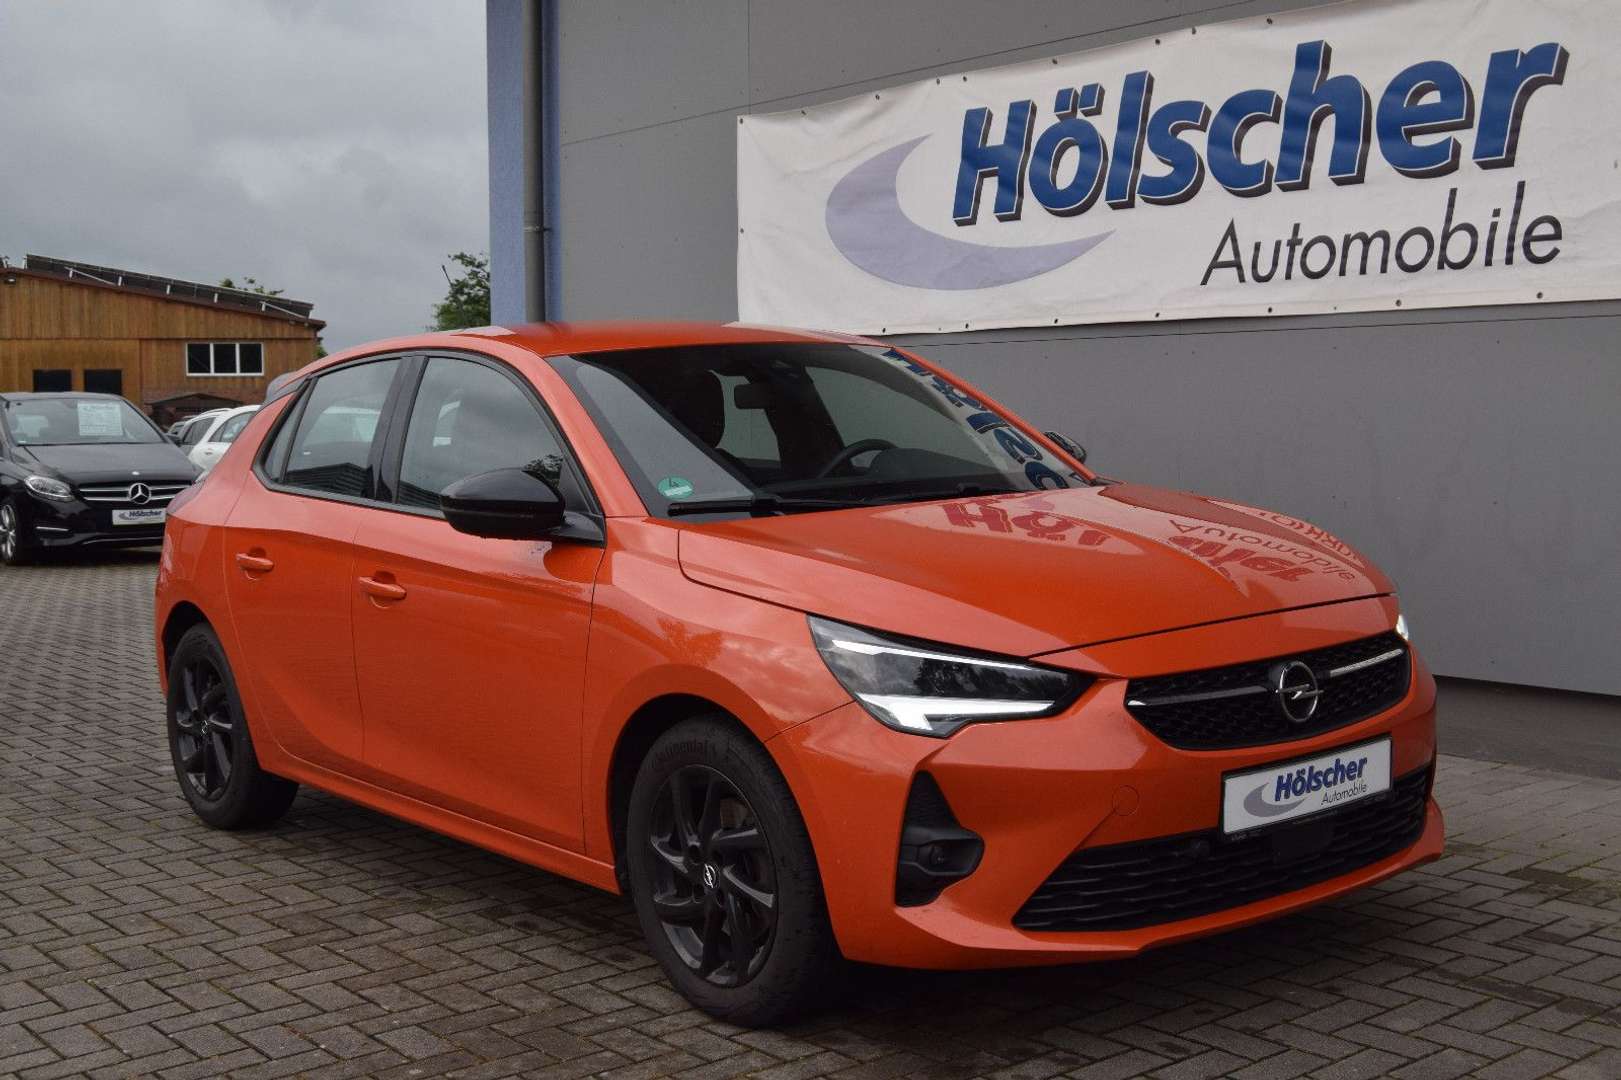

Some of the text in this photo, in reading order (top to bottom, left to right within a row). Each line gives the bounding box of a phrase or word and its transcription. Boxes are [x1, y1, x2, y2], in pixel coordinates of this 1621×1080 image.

[953, 40, 1569, 227] Hölscher
[1200, 180, 1563, 286] Automobile
[1275, 757, 1368, 802] Hölscher
[1320, 781, 1368, 806] Automobile
